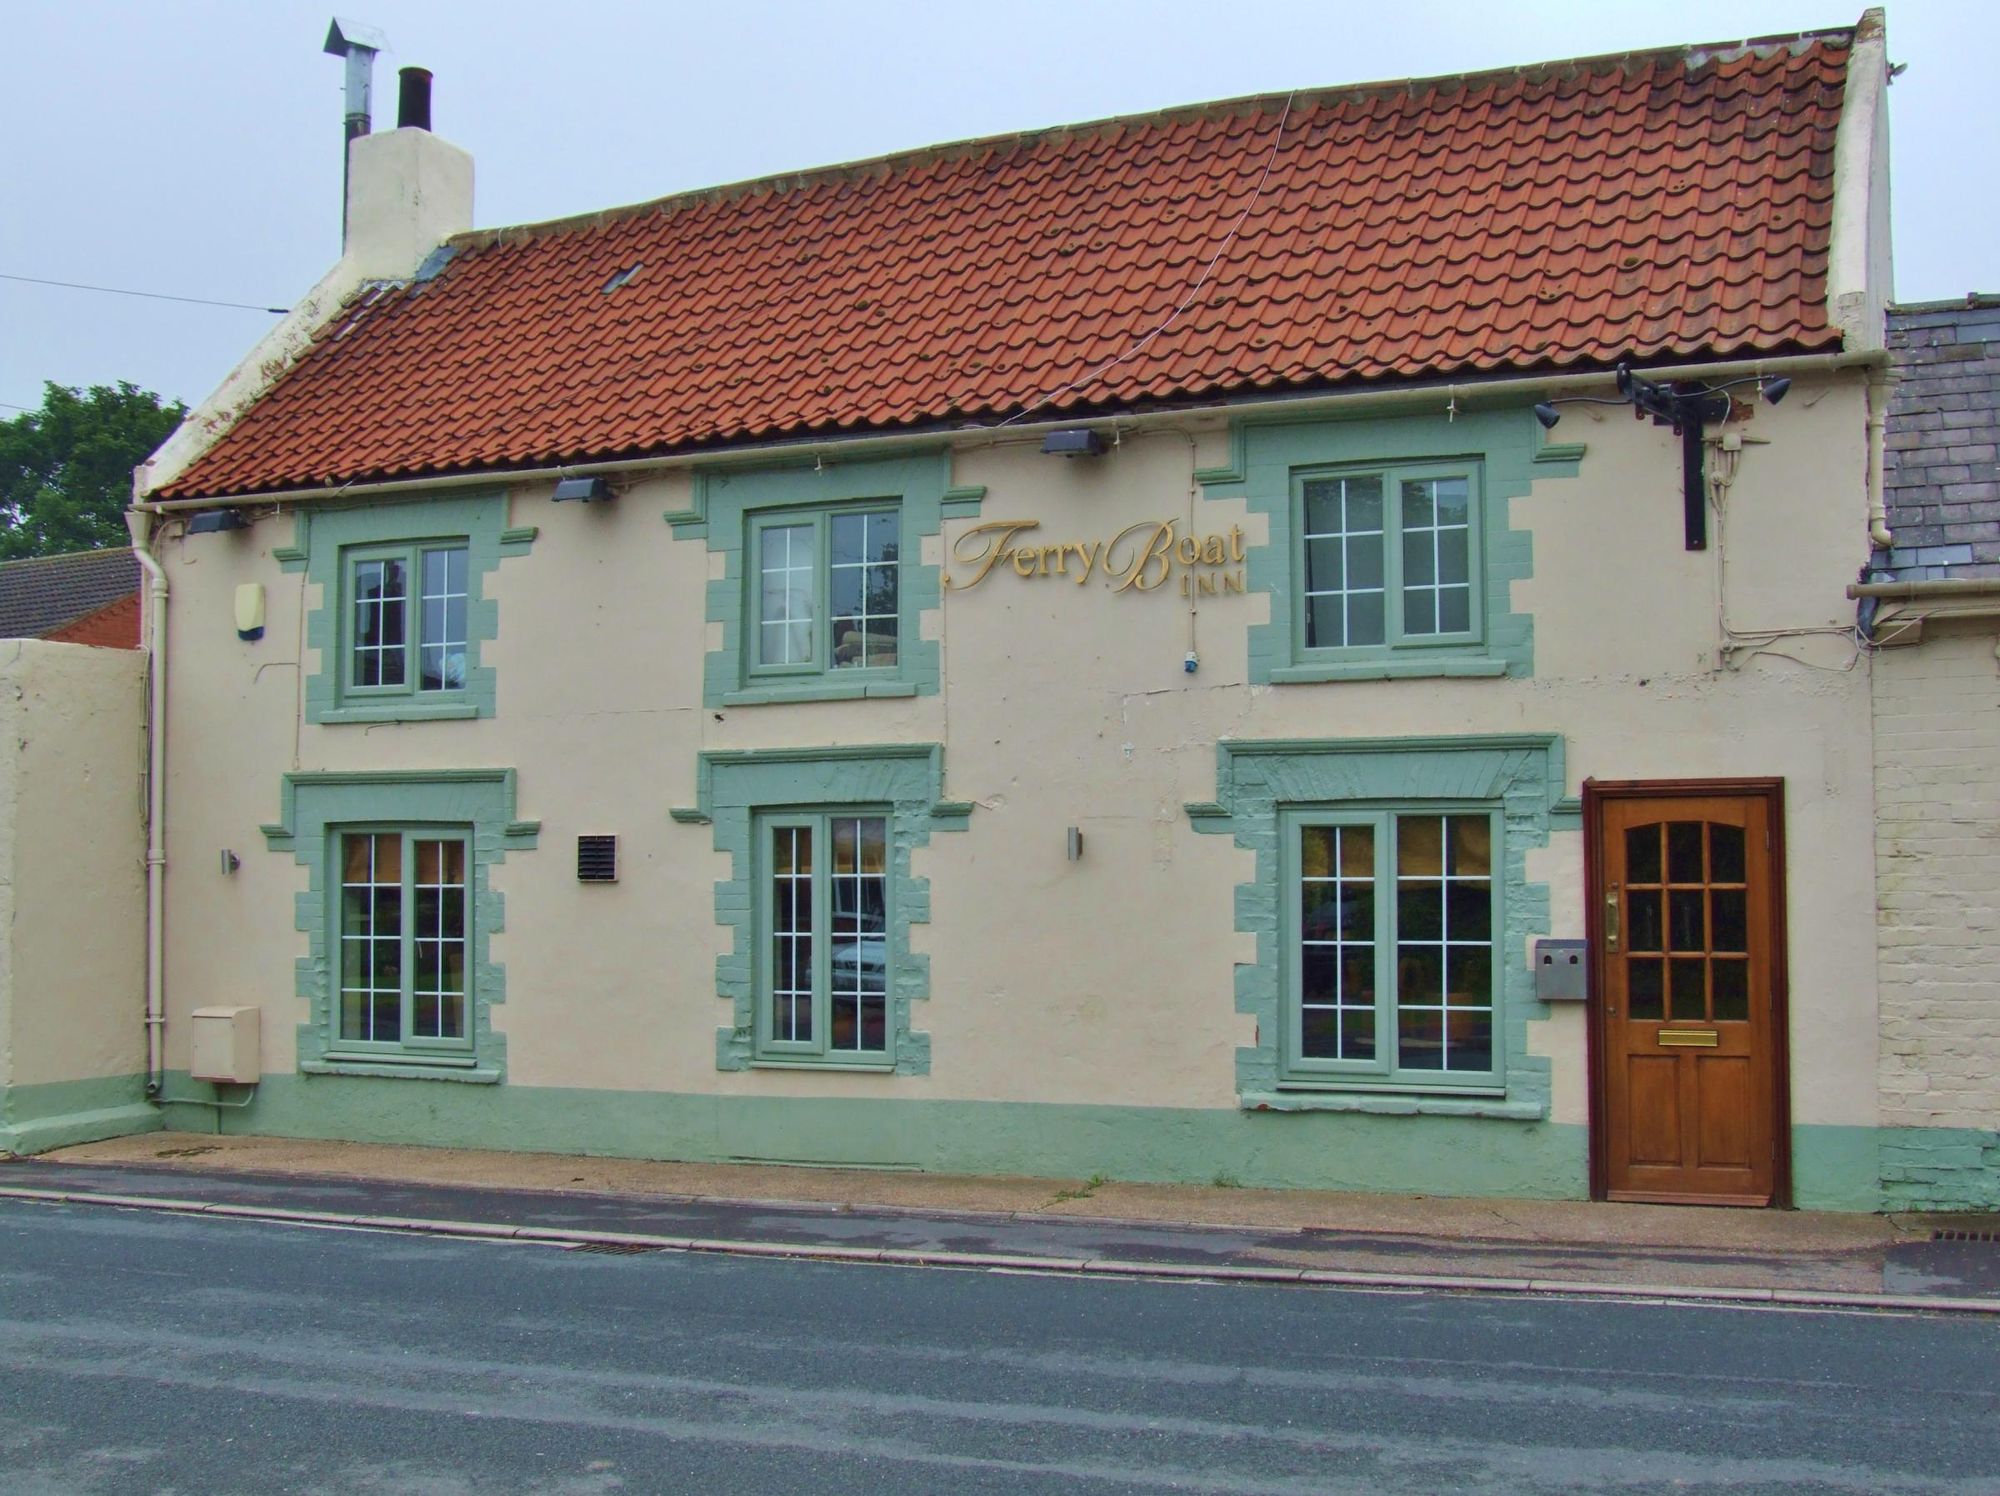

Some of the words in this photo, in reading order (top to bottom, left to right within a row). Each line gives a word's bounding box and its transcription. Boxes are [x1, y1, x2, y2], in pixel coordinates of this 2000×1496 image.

[943, 520, 1101, 591] Ferry
[1103, 518, 1245, 593] Boat
[1180, 570, 1244, 596] INN
